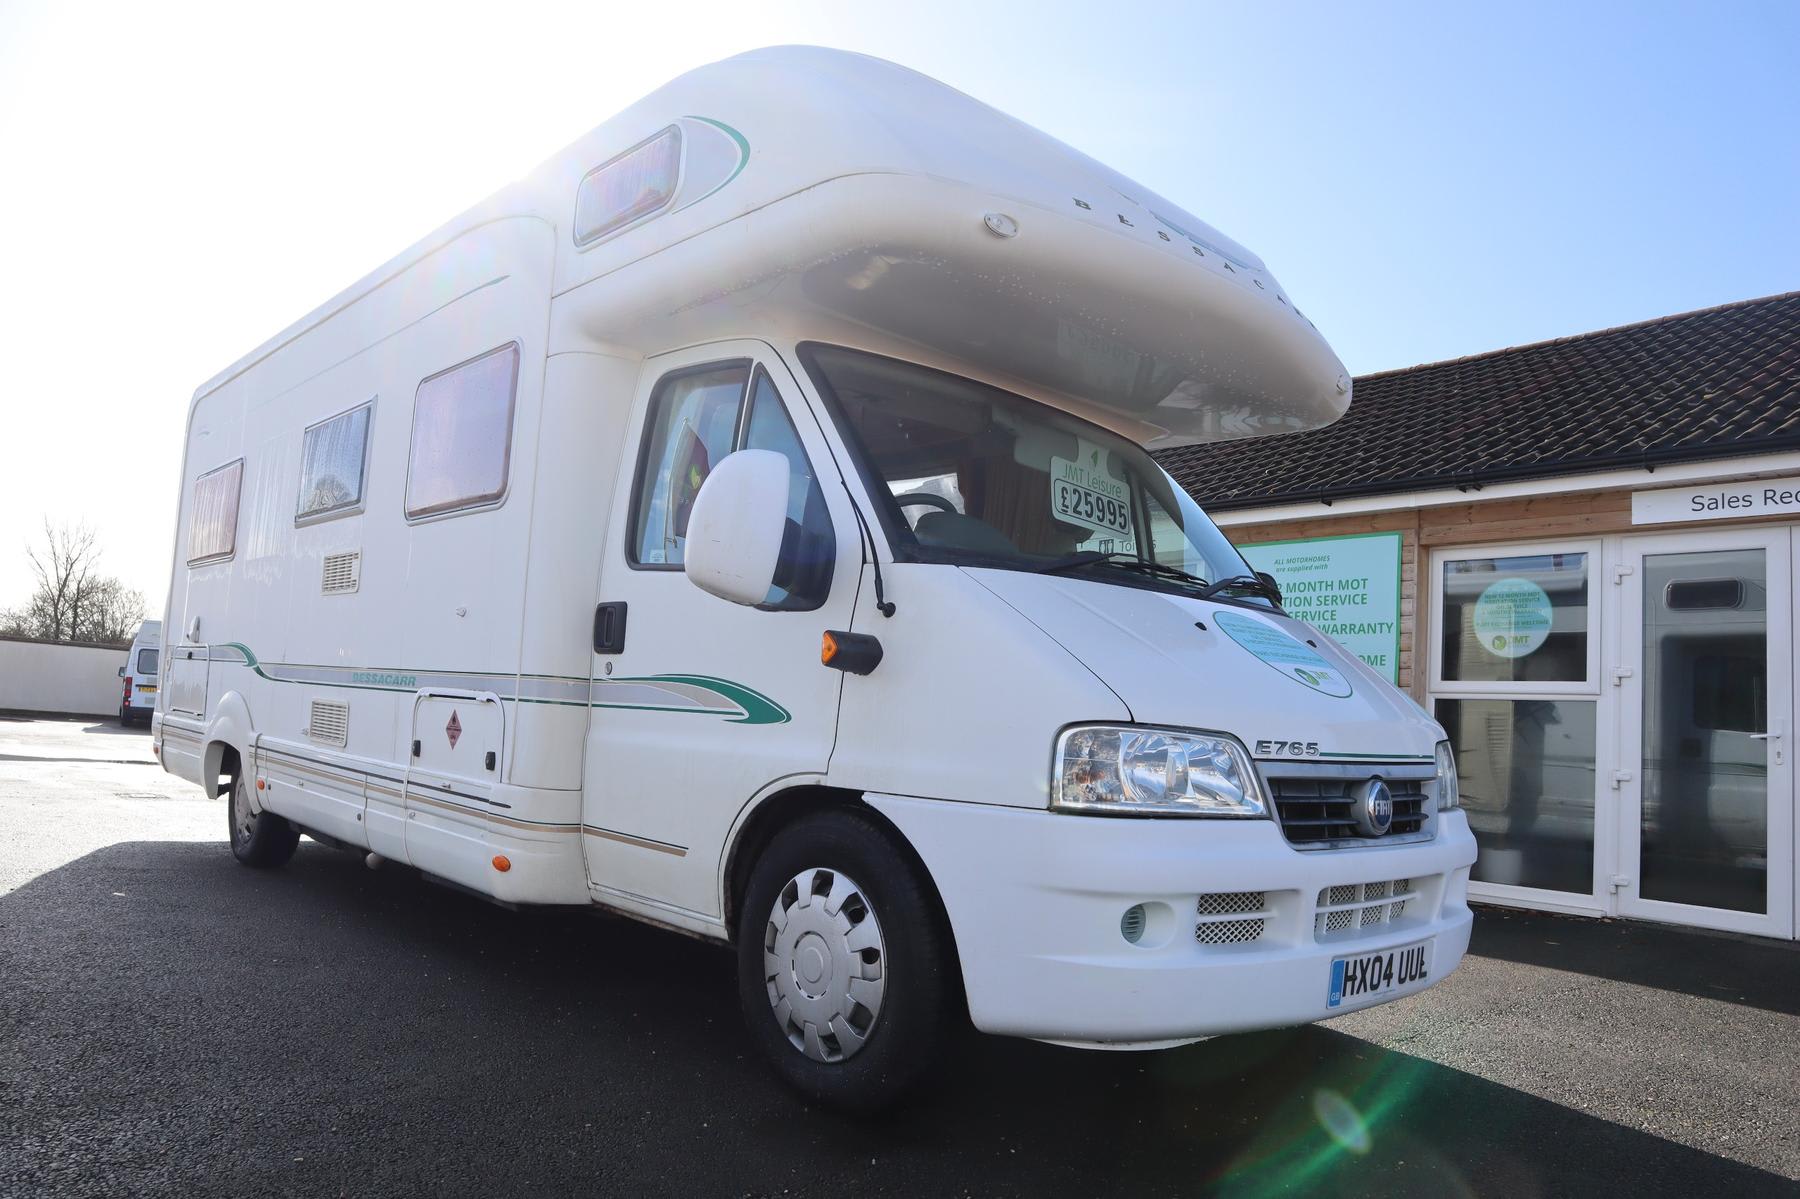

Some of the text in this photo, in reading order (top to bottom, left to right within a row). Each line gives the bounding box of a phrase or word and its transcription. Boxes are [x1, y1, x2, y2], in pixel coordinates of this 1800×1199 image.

[1063, 464, 1122, 498] JMT Leisure
[1060, 486, 1127, 530] £25995
[1691, 492, 1753, 512] Sales
[1286, 555, 1331, 564] MOTORHOMES
[1287, 564, 1313, 573] supplied
[1314, 563, 1329, 571] with
[1286, 580, 1334, 593] MONTH
[1338, 578, 1368, 591] MOT
[1282, 593, 1368, 608] TION SERVICE
[1318, 621, 1394, 635] WARRANTY
[1254, 739, 1321, 757] E765
[1375, 800, 1391, 816] FIAT
[1330, 946, 1428, 1002] GB HX04 UUL
